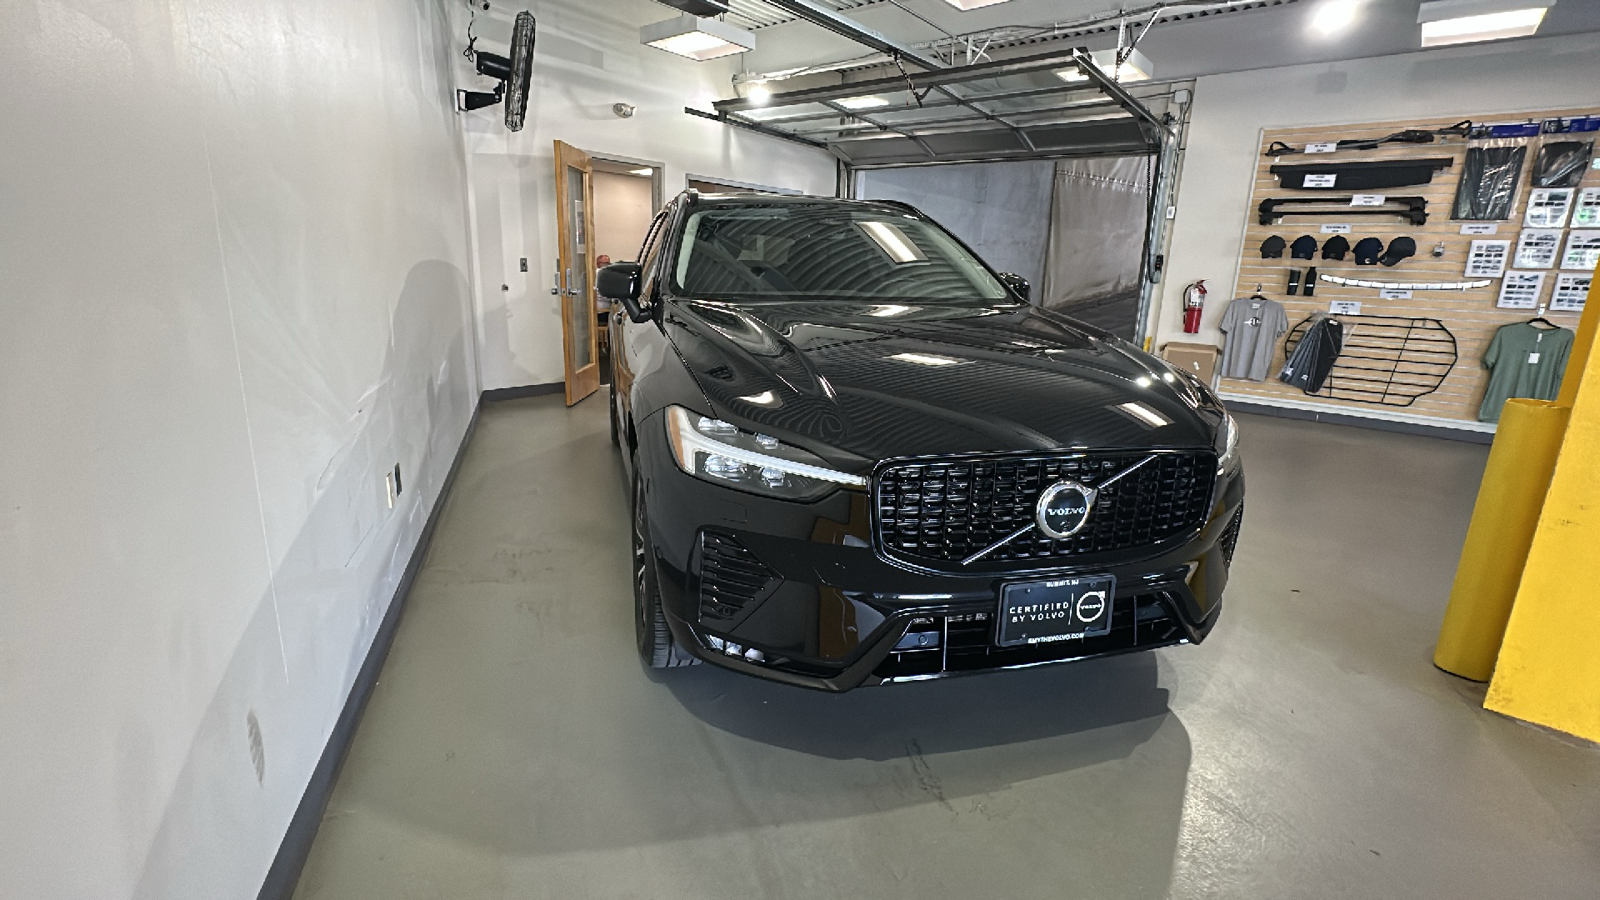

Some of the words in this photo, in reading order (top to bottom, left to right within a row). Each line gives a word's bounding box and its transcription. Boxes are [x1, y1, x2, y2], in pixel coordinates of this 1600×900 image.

[1047, 506, 1086, 516] VOLVO
[1009, 601, 1069, 614] CERTIFIED
[1012, 613, 1026, 623] BY
[1030, 611, 1065, 621] VOLVO
